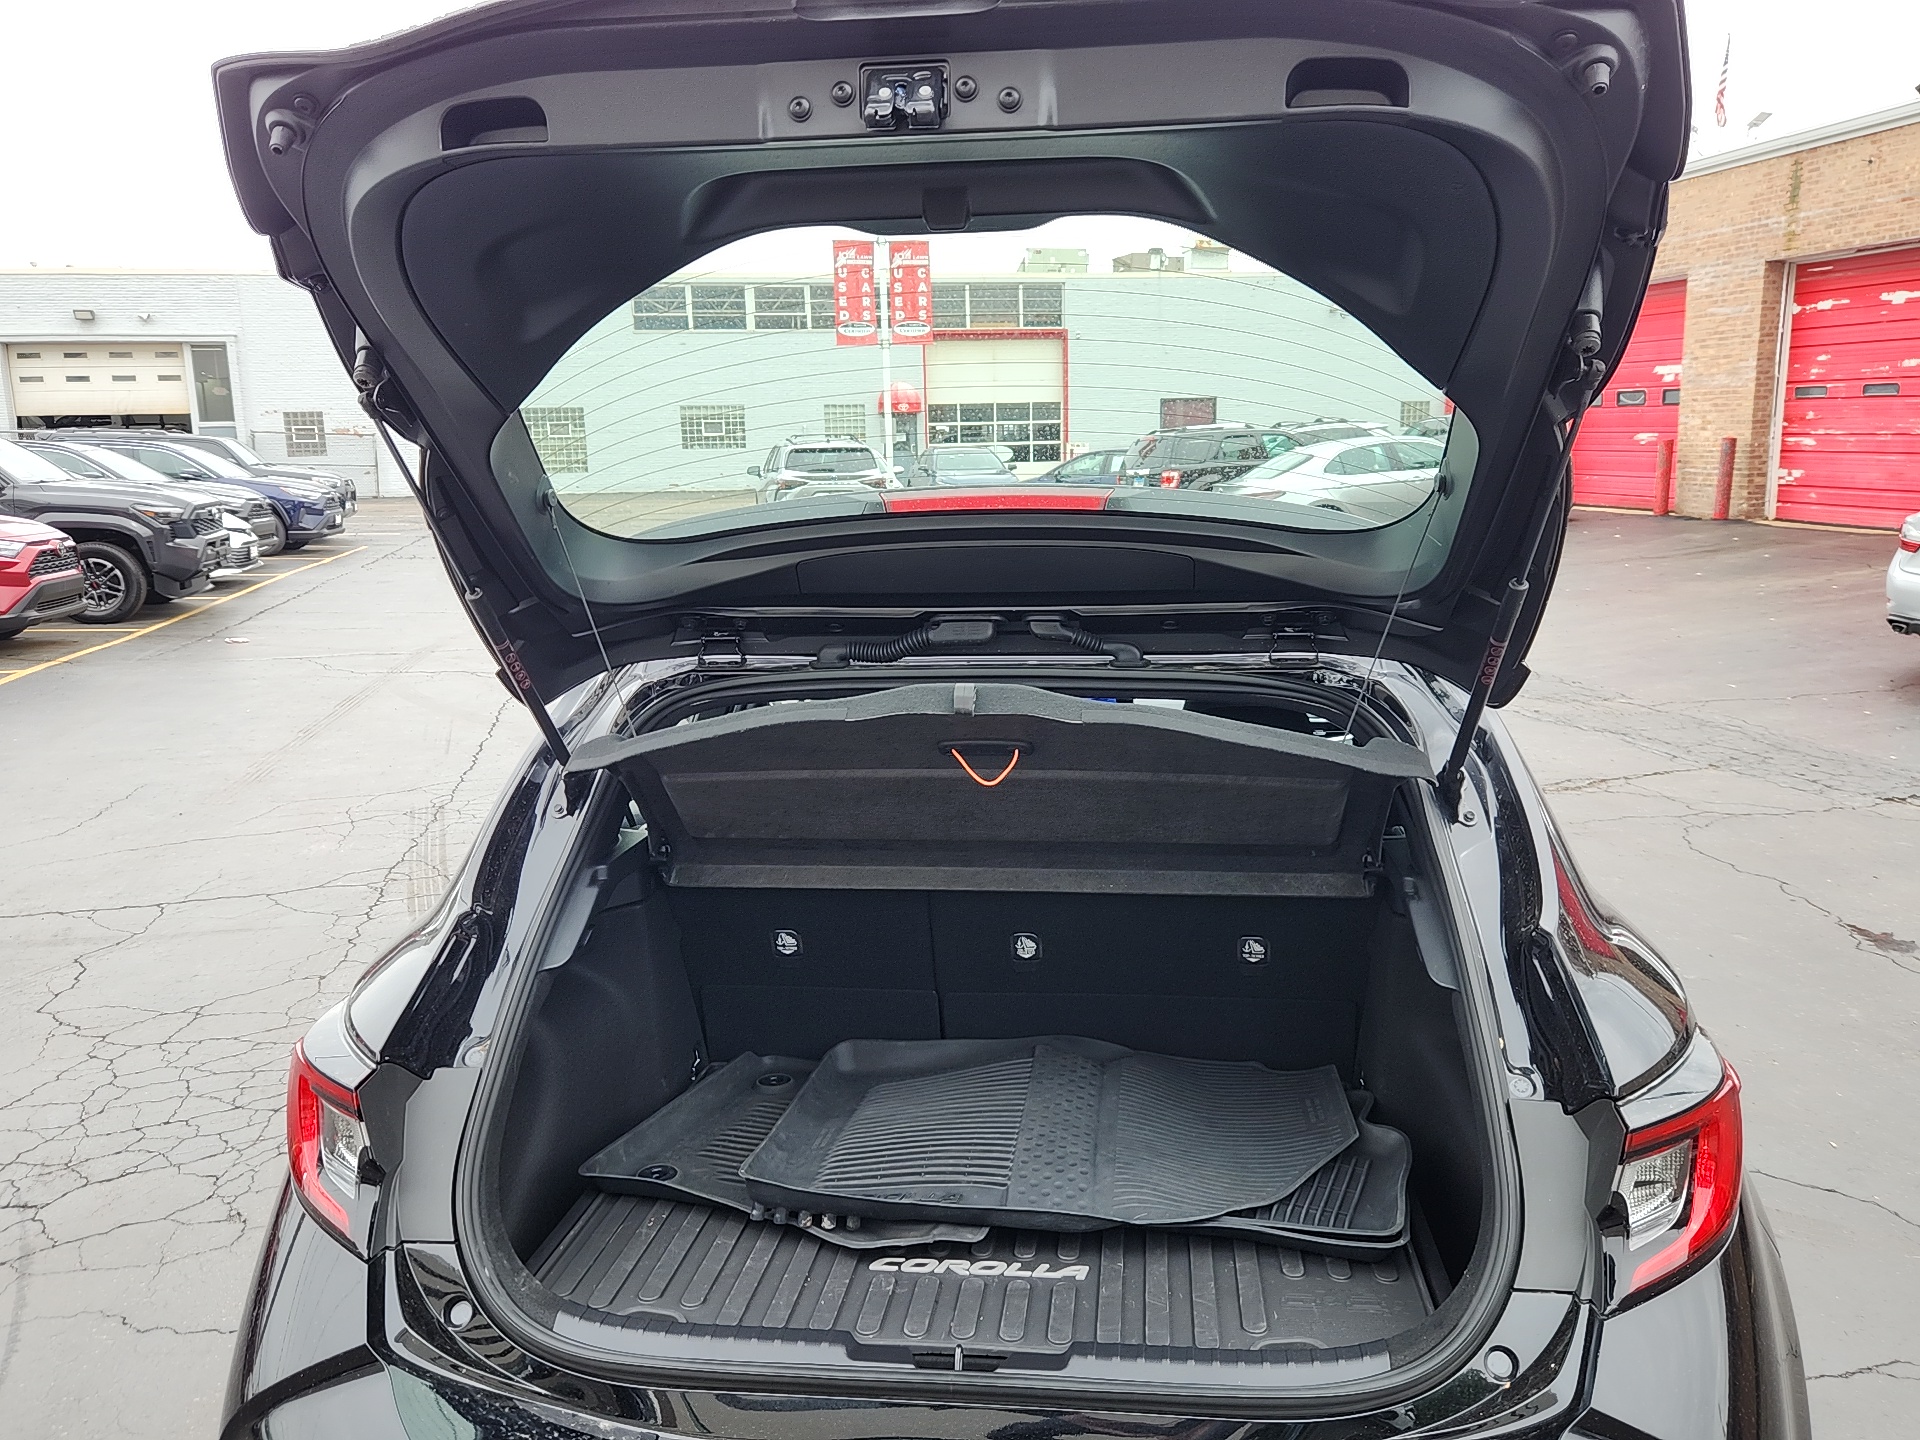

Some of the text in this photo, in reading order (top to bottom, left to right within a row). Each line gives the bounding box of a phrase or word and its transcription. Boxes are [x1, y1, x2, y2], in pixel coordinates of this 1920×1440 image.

[838, 268, 872, 321] USED CARS
[893, 268, 928, 321] USED CARS
[868, 1257, 1090, 1281] COROLLA
